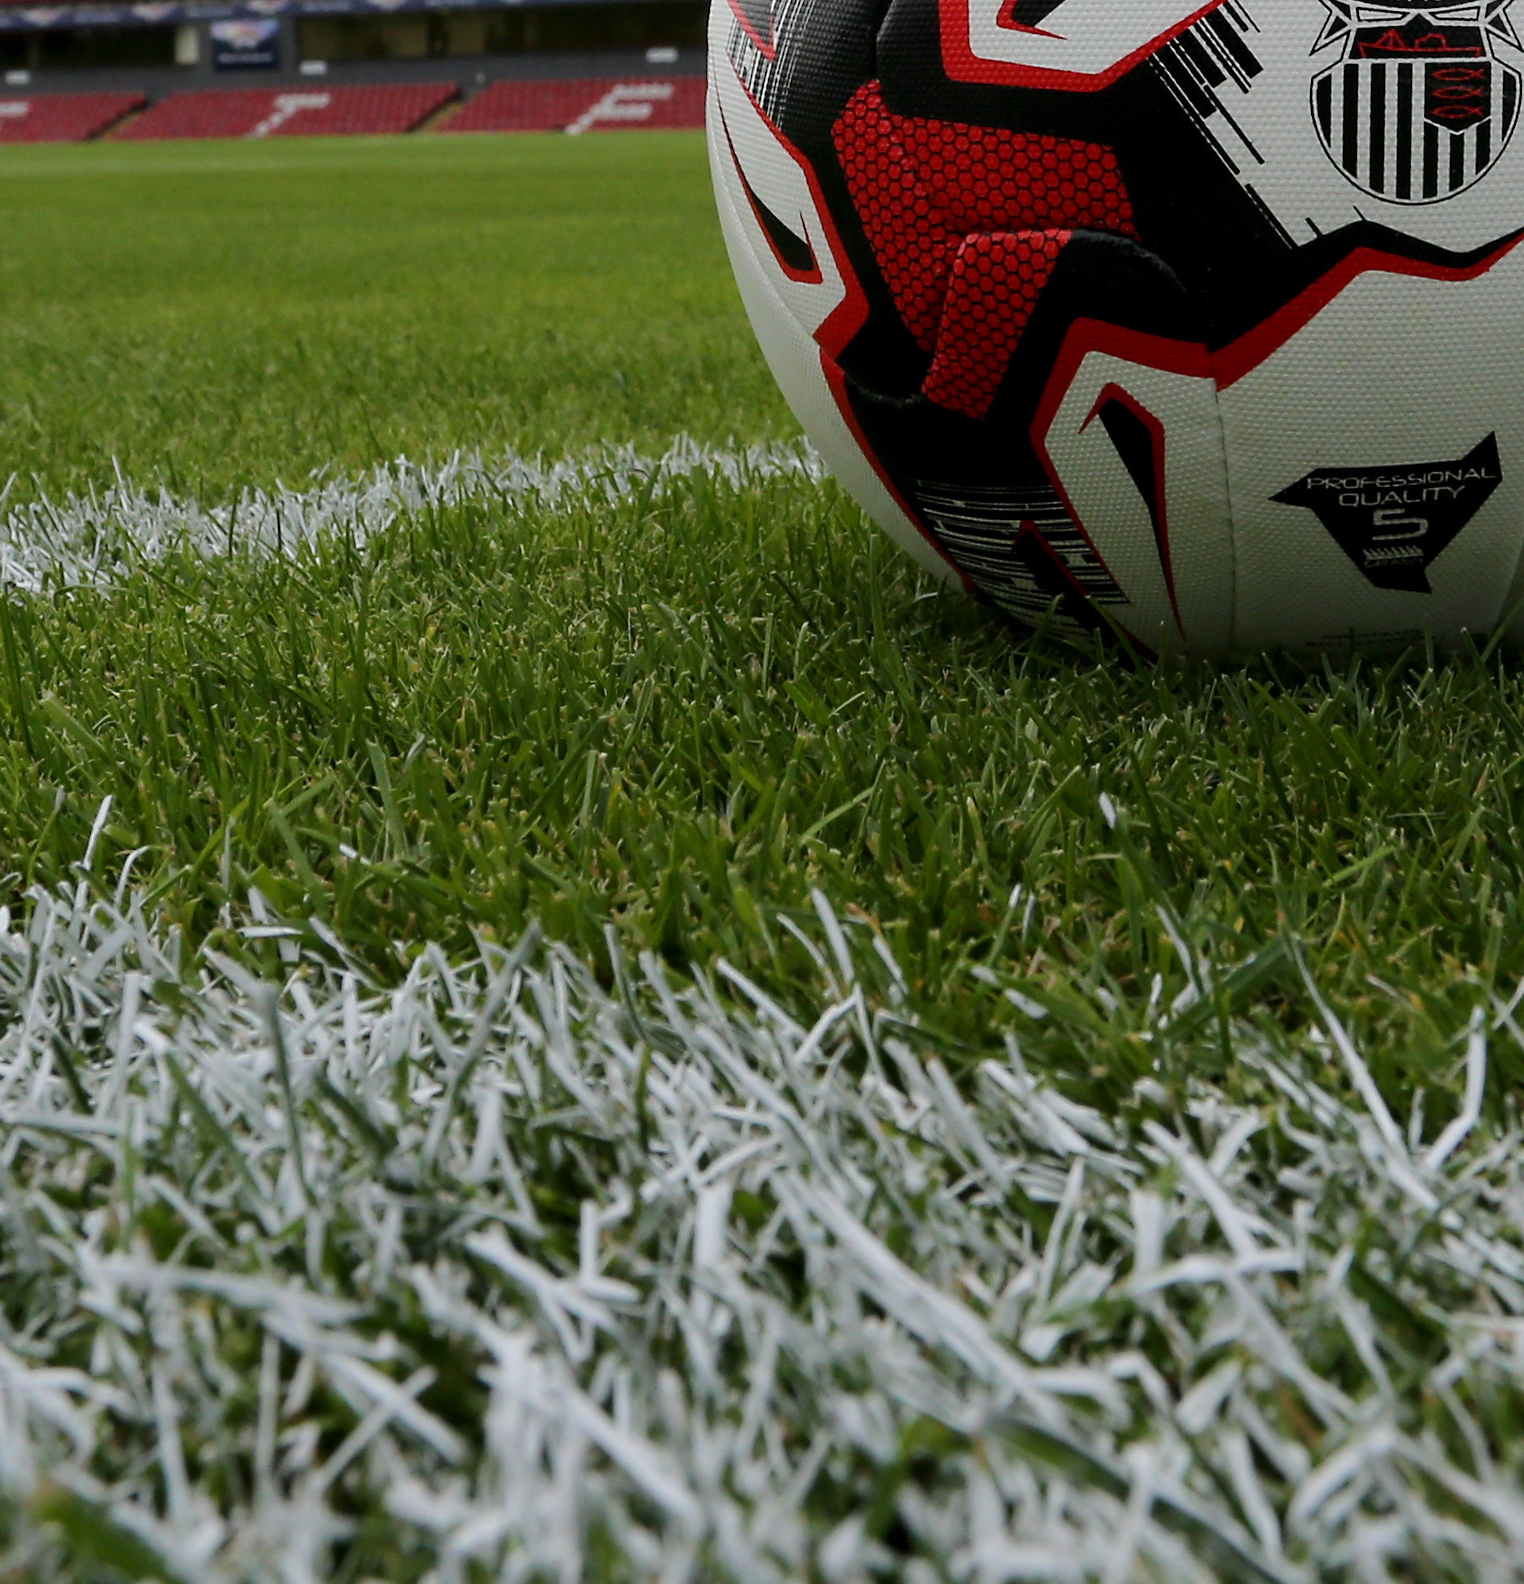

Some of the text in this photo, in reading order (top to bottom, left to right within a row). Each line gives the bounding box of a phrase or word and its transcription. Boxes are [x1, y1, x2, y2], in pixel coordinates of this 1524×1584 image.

[1307, 468, 1497, 489] PROFESSIONAL
[1338, 485, 1465, 508] QUALITY
[1372, 508, 1429, 541] 5
